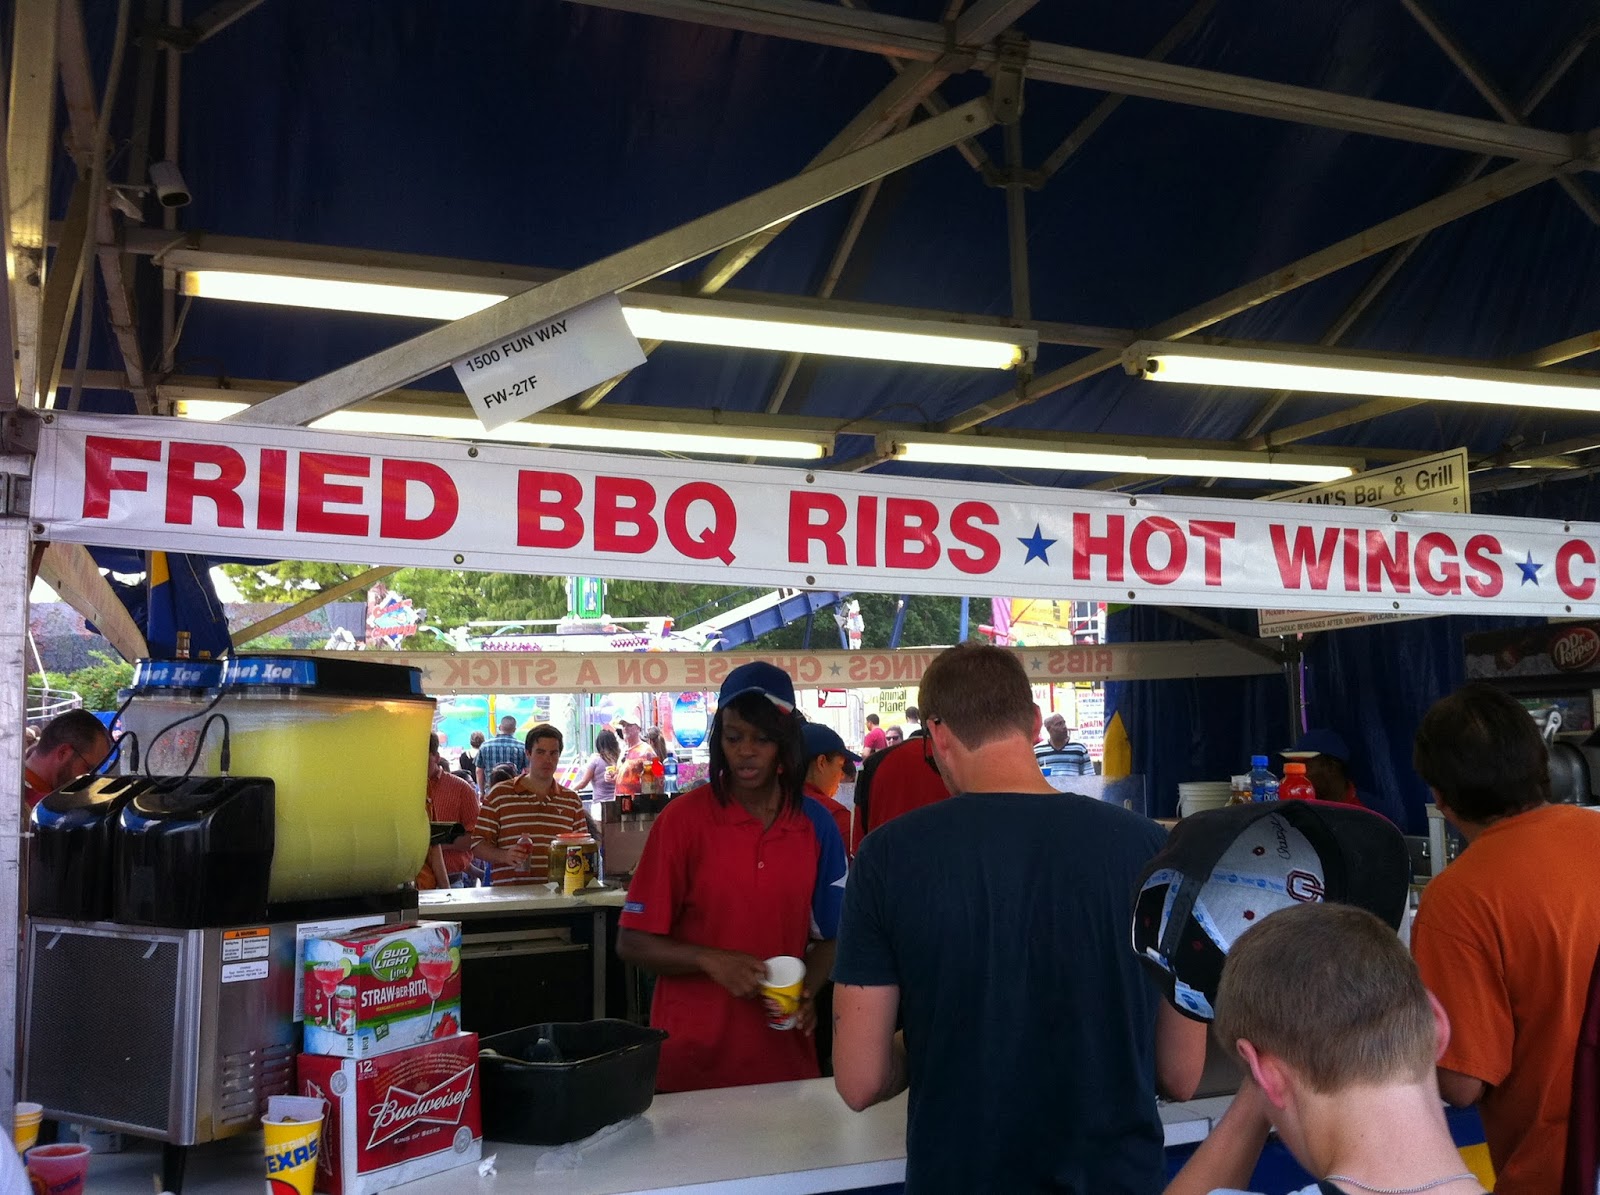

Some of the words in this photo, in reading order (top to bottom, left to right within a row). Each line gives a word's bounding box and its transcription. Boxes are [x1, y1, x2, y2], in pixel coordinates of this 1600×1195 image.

[466, 349, 500, 372] 1500
[502, 334, 535, 358] FUN
[535, 319, 568, 343] WAY
[484, 375, 539, 409] FW-27F
[1355, 482, 1385, 505] Bar
[1394, 476, 1406, 496] &
[1416, 464, 1453, 491] Grill
[82, 435, 459, 541] FRIED
[517, 470, 737, 566] BBQ
[788, 490, 1000, 574] RIBS
[1072, 512, 1235, 586] HOT
[1269, 523, 1503, 598] WINGS
[1270, 624, 1296, 634] ALCOHOLIC
[1297, 620, 1326, 631] BEVERAGES
[1327, 617, 1344, 626] AFTER
[1569, 633, 1586, 647] Dr
[1559, 637, 1595, 666] Pepper
[262, 663, 292, 679] Ice
[879, 689, 907, 701] Animal
[879, 701, 907, 712] Planet
[382, 947, 410, 959] BUD
[374, 955, 412, 970] LIGHT
[357, 1059, 373, 1074] 12
[368, 1088, 472, 1130] Budweiser
[264, 1138, 318, 1173] EXAS
